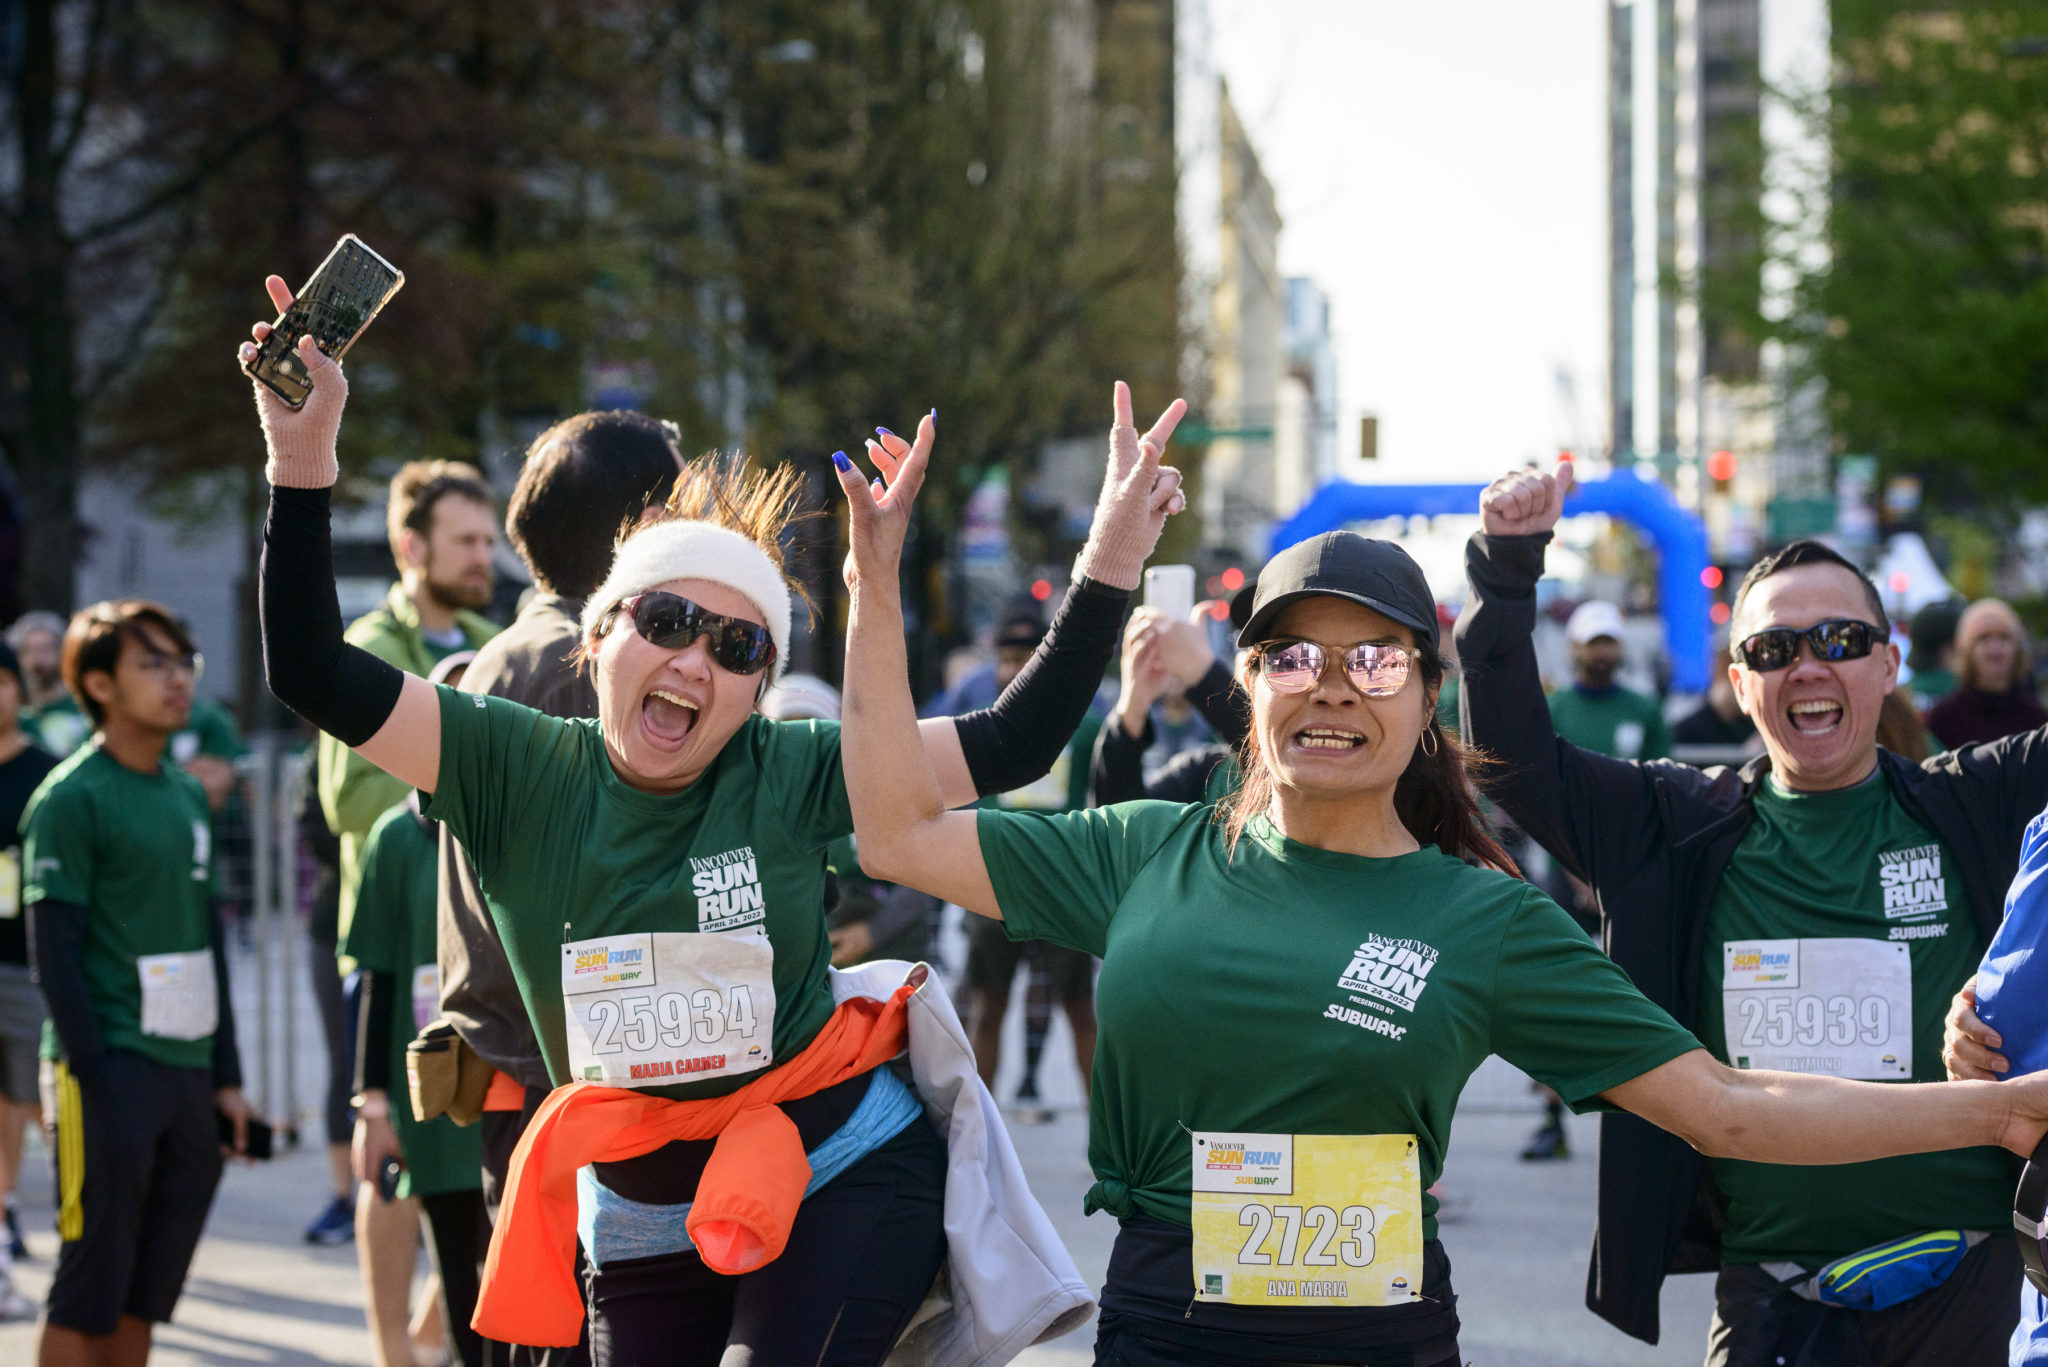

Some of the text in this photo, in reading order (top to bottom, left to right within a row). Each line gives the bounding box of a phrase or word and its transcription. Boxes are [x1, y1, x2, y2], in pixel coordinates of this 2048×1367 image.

[689, 846, 755, 873] VANCOUVER
[1880, 856, 1940, 888] SUN
[692, 858, 758, 897] SUN
[698, 882, 763, 922] RUN
[1884, 878, 1945, 909] RUN
[703, 922, 727, 931] APRIL
[742, 911, 761, 921] 2022
[1888, 923, 1949, 940] SUBWAY
[1354, 942, 1435, 980] SUN
[1368, 933, 1439, 963] VANCOUVER
[602, 971, 642, 983] SUBWAY
[1342, 957, 1427, 1002] RUN
[1343, 980, 1369, 991] APRIL
[1387, 993, 1410, 1007] 2022
[1349, 995, 1395, 1015] PRESENTED BY
[588, 984, 757, 1056] 25934
[1739, 994, 1891, 1048] 25939
[630, 1055, 726, 1079] MARIA CARMEN
[1210, 1141, 1246, 1151] VANCOUVER
[1234, 1176, 1279, 1185] SUBWAY
[1237, 1203, 1376, 1268] 2723
[1266, 1280, 1348, 1297] ANA MARIA
